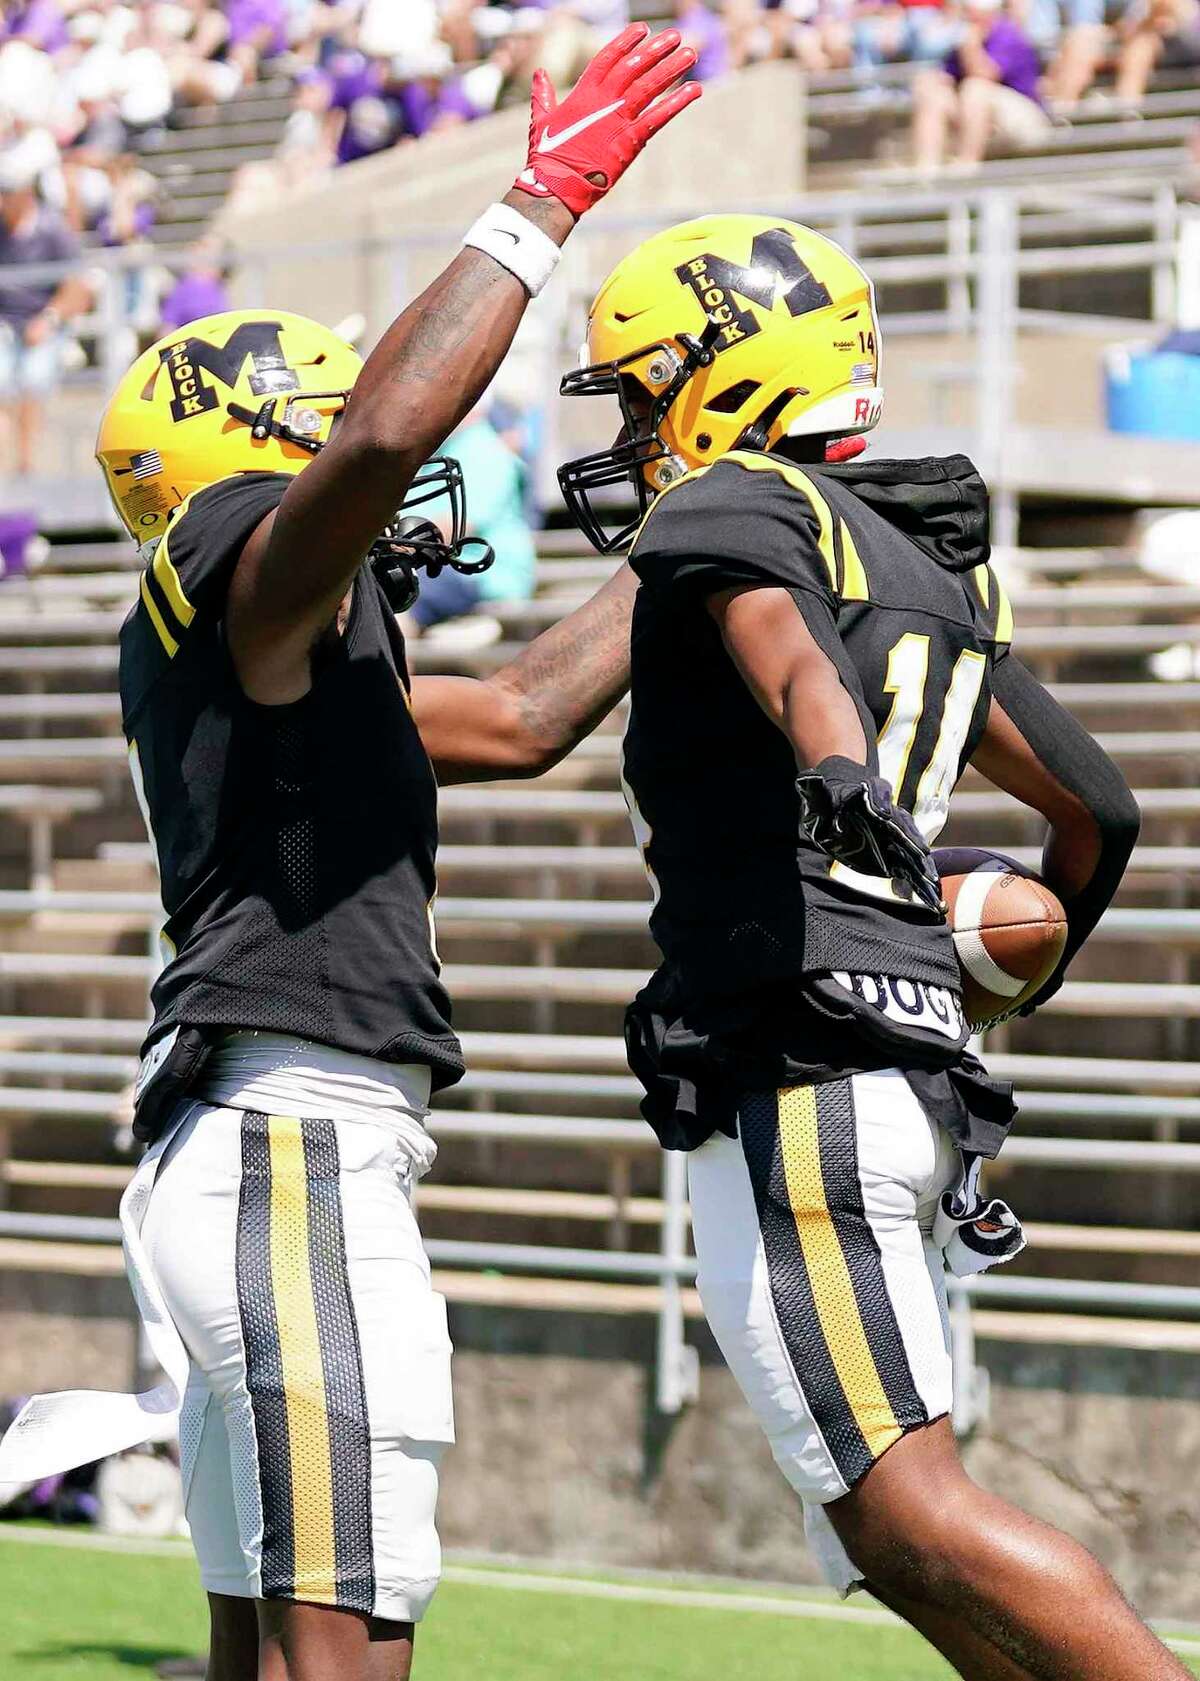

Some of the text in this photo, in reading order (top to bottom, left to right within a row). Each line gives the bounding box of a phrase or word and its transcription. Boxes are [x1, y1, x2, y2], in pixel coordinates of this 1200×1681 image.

[674, 227, 834, 355] M
[687, 257, 746, 344] BLOCK
[158, 321, 301, 423] M
[169, 341, 205, 417] BLOCK
[858, 331, 875, 355] 14
